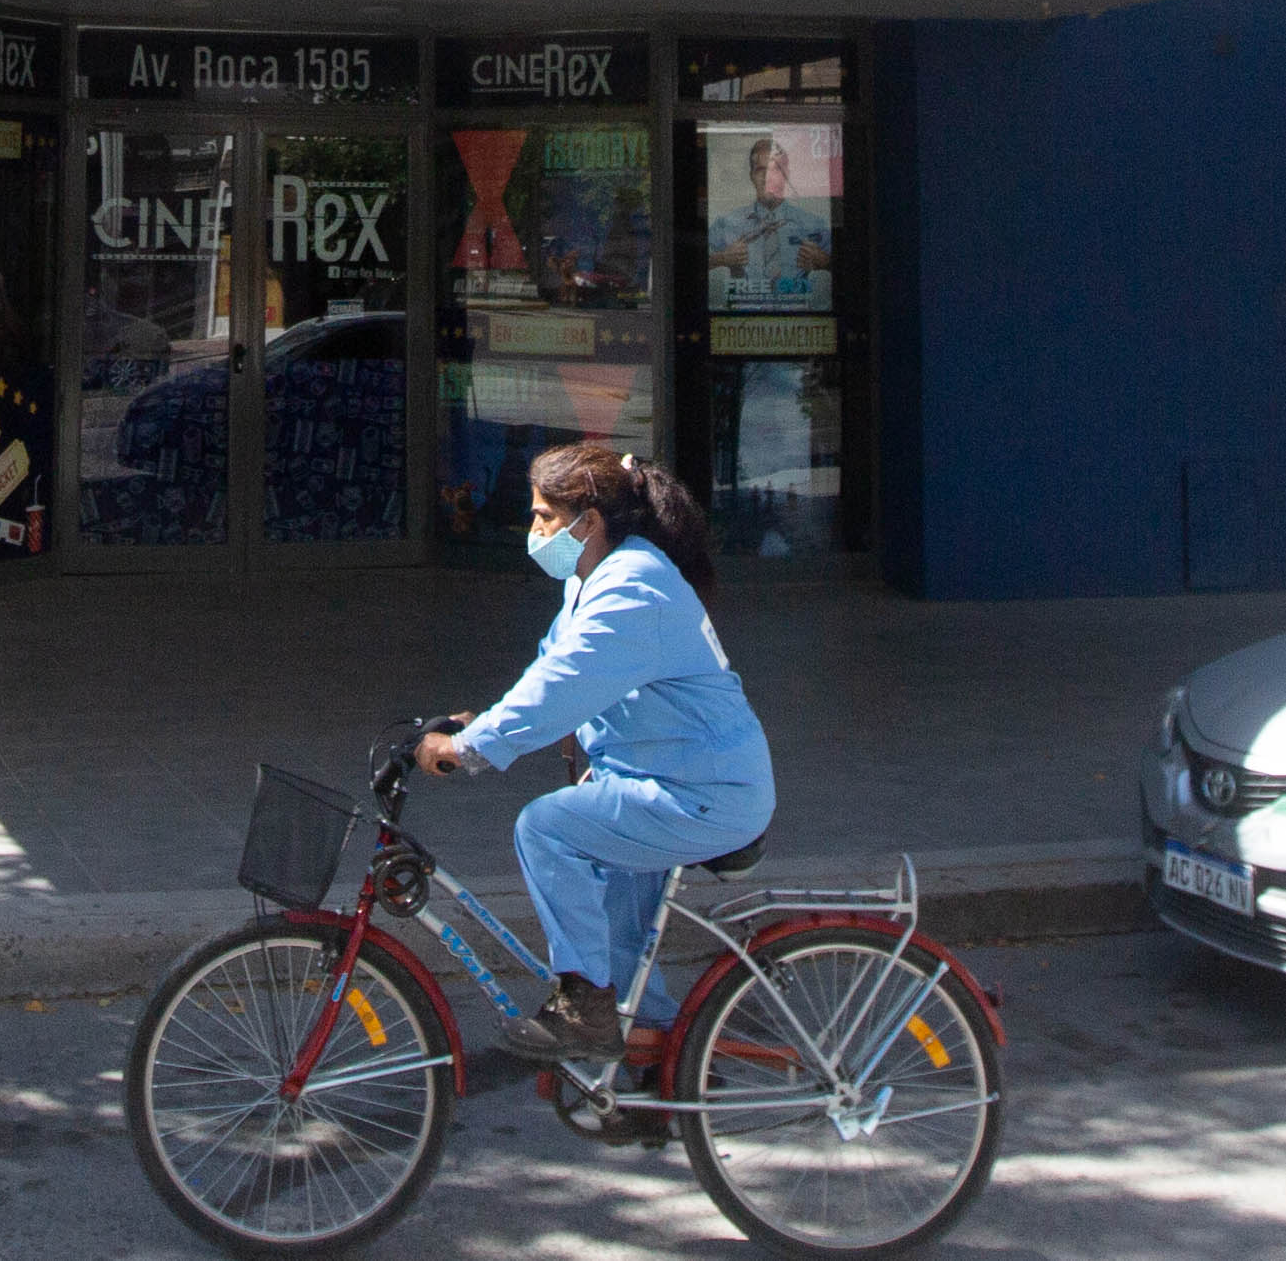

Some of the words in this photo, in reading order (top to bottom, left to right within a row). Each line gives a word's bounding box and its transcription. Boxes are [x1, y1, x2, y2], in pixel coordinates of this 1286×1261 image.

[129, 43, 178, 88] Av.
[193, 45, 278, 89] Roca
[294, 48, 371, 91] 1585
[90, 197, 226, 249] CINE
[725, 279, 773, 293] FREE
[1169, 856, 1189, 886] AC
